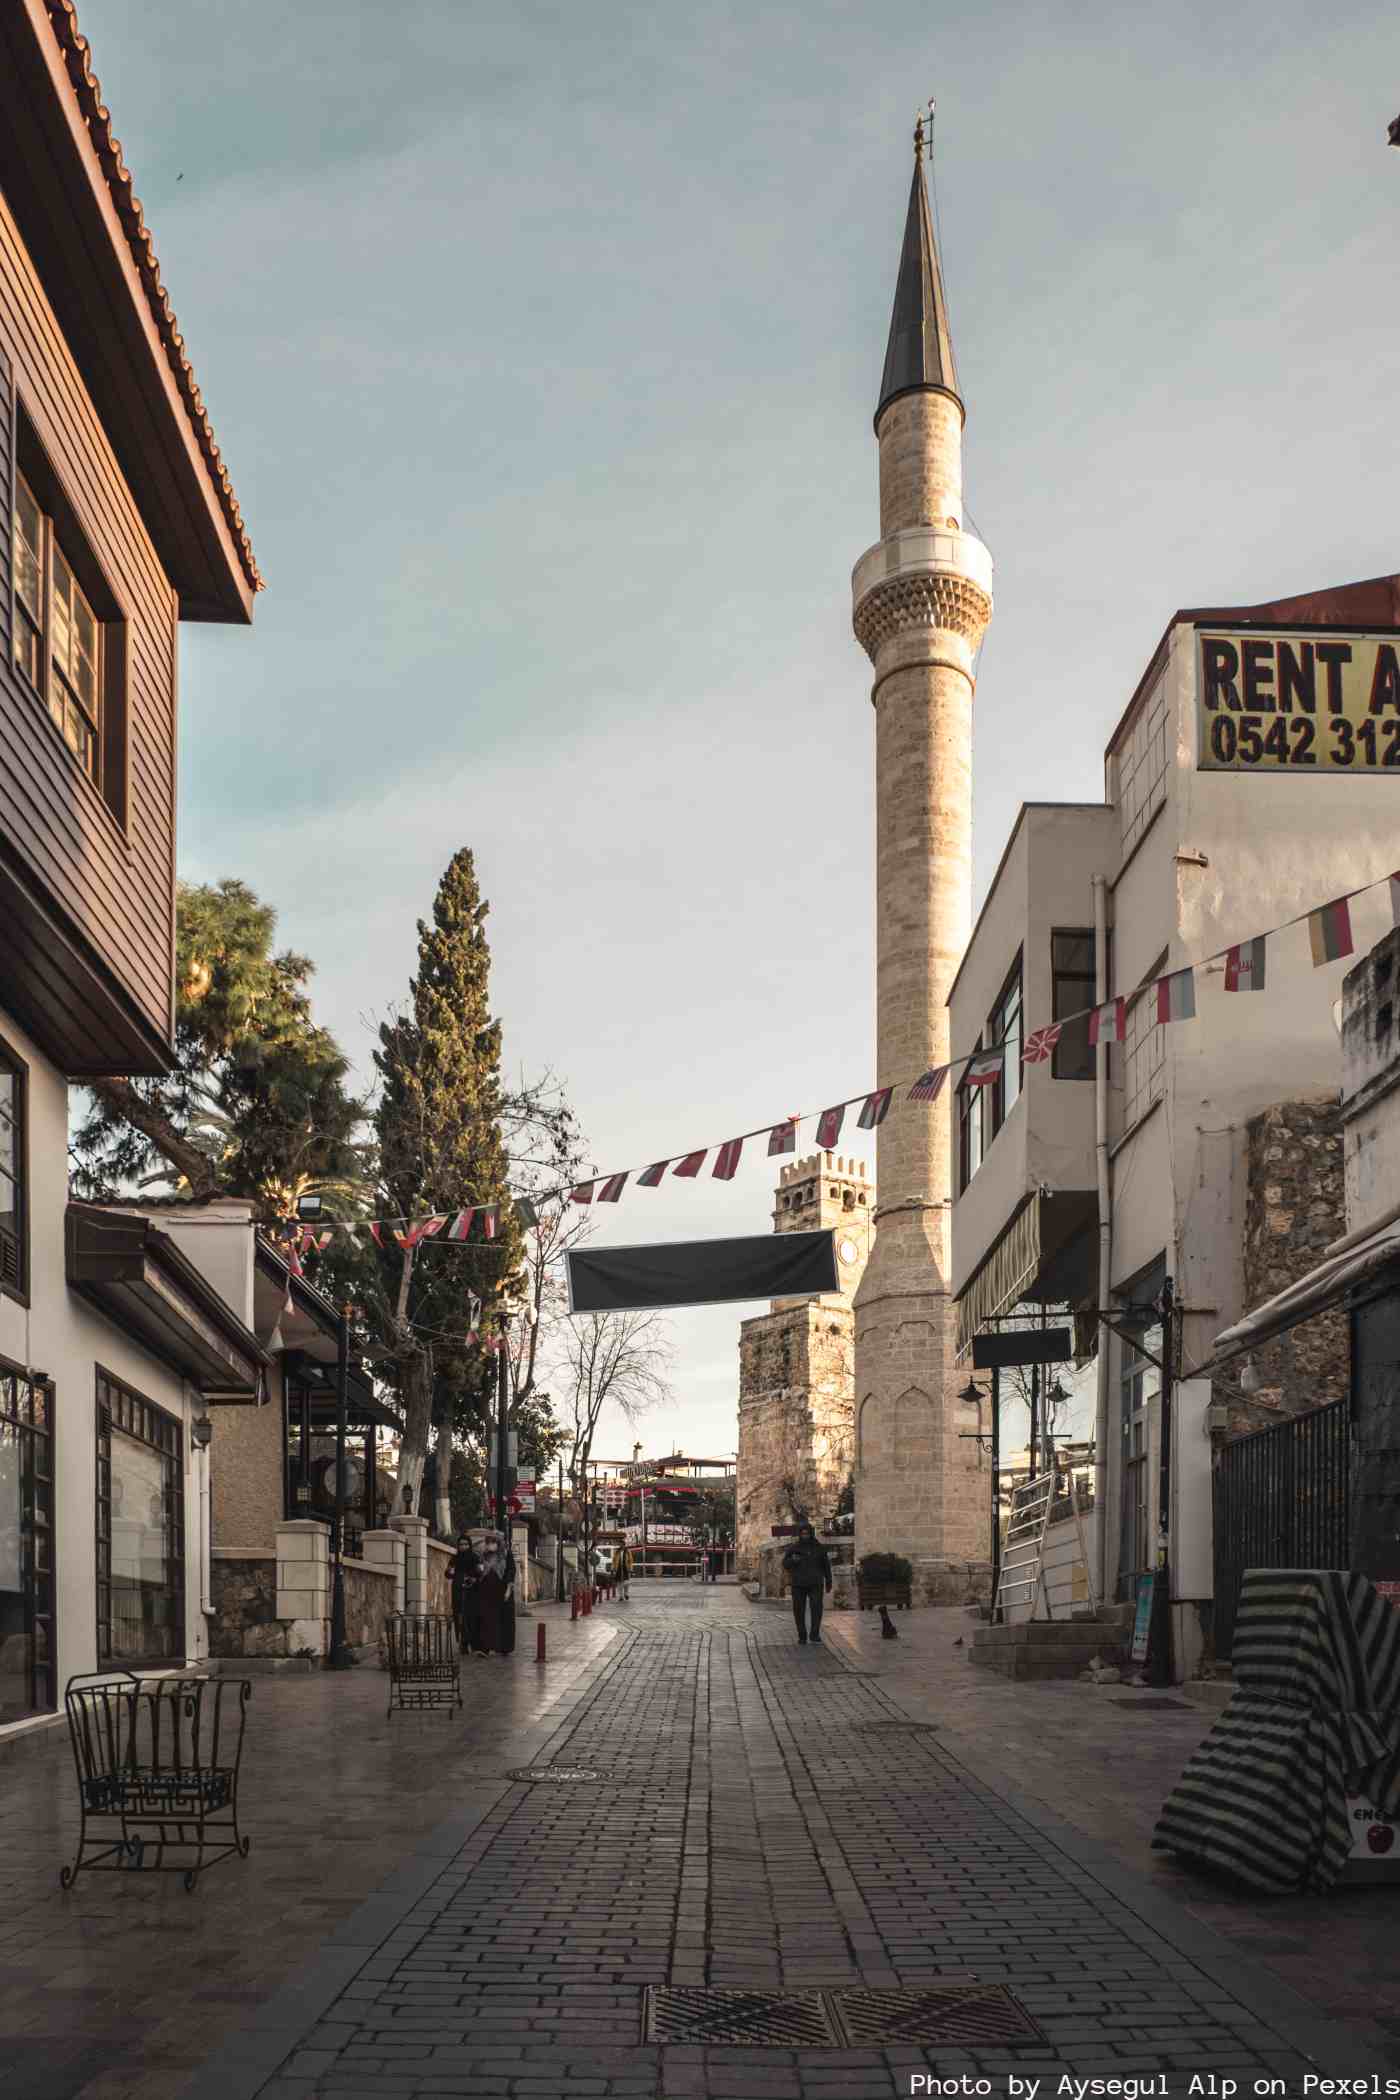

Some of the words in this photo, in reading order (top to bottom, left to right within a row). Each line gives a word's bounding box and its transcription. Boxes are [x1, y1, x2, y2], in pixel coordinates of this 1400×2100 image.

[1201, 638, 1353, 715] RENT
[1210, 714, 1317, 764] 0542
[1328, 717, 1400, 766] 312
